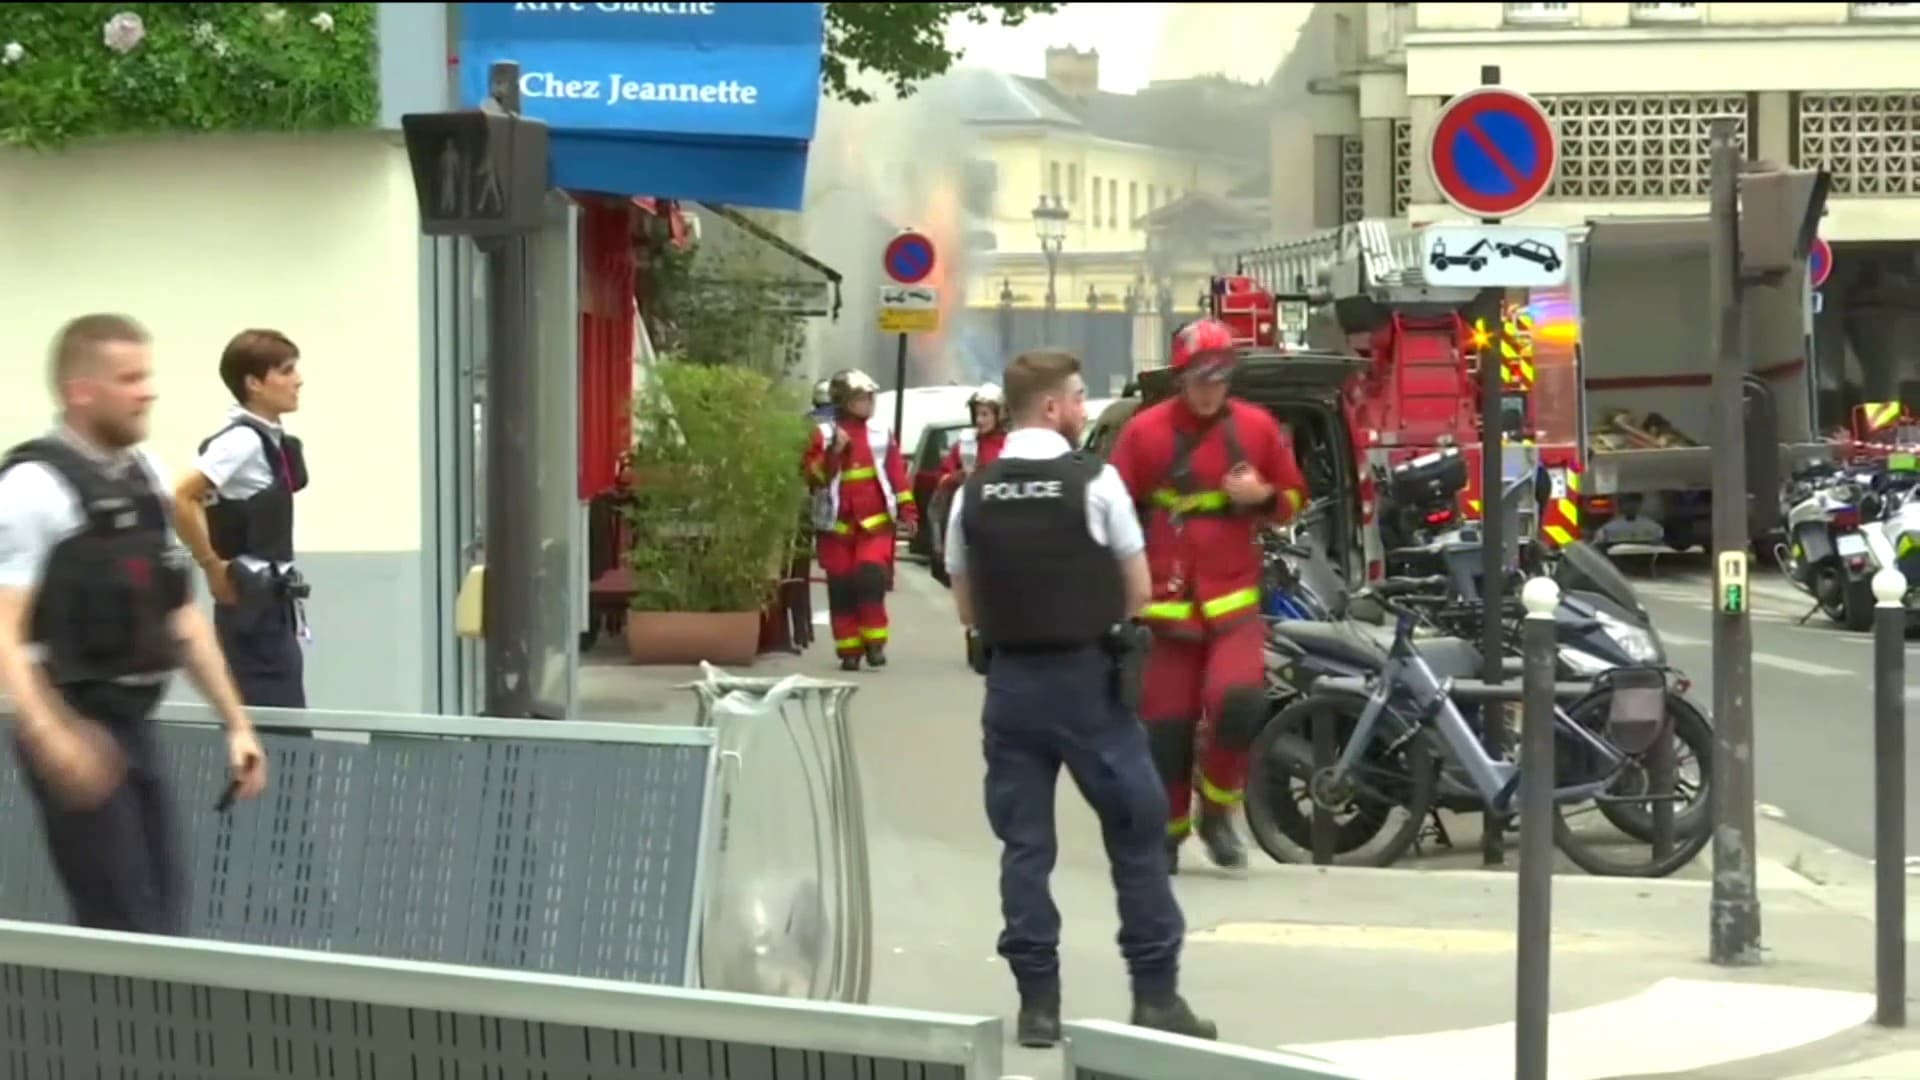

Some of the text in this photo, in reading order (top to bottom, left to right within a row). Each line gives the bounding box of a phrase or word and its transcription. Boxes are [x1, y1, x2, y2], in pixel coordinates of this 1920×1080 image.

[519, 72, 758, 105] Chez Jeannette
[981, 480, 1063, 500] POLICE
